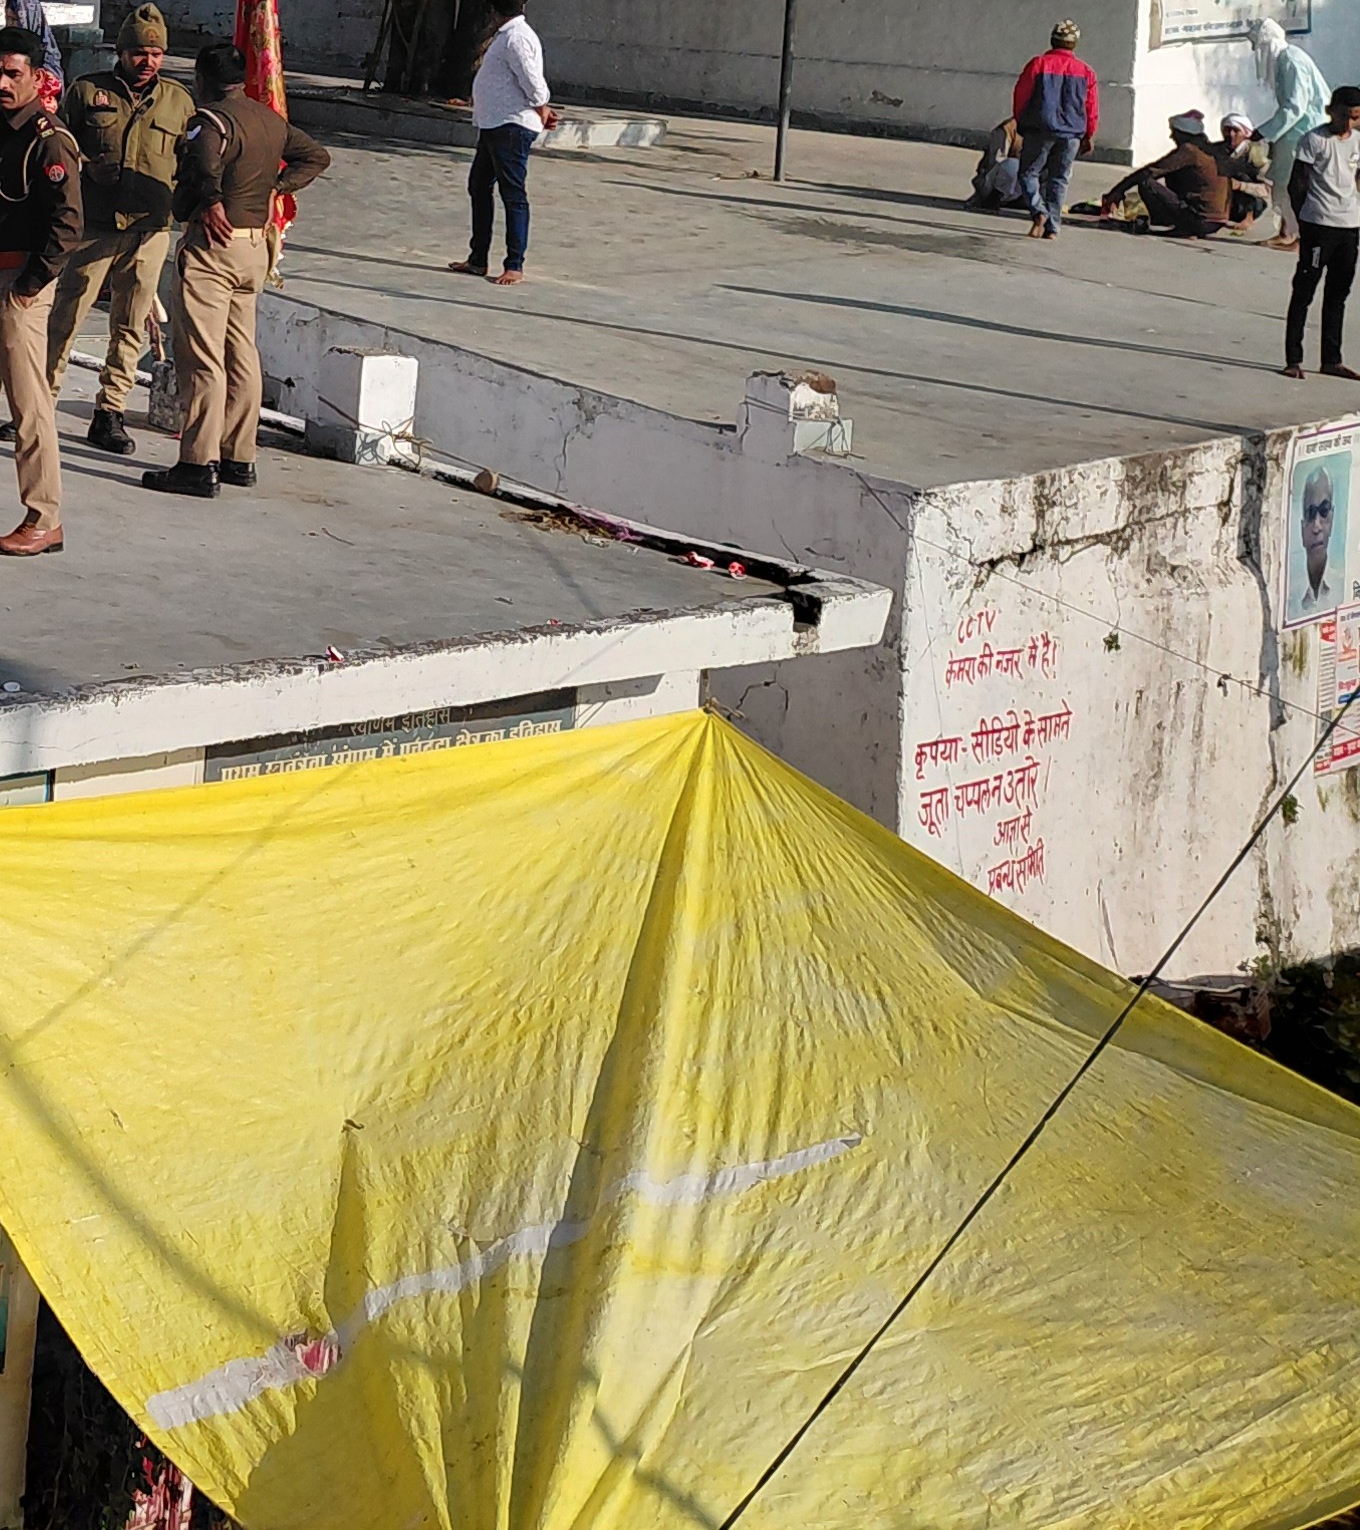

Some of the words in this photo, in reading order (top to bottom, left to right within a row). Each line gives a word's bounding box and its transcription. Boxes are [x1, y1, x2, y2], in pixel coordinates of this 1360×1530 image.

[977, 642, 994, 679] की
[1028, 635, 1040, 669] में
[1022, 709, 1036, 751] के
[1036, 698, 1073, 749] सामने
[917, 787, 949, 839] जूता
[953, 778, 991, 819] चप्पल
[991, 774, 1003, 807] न
[1020, 805, 1033, 845] से
